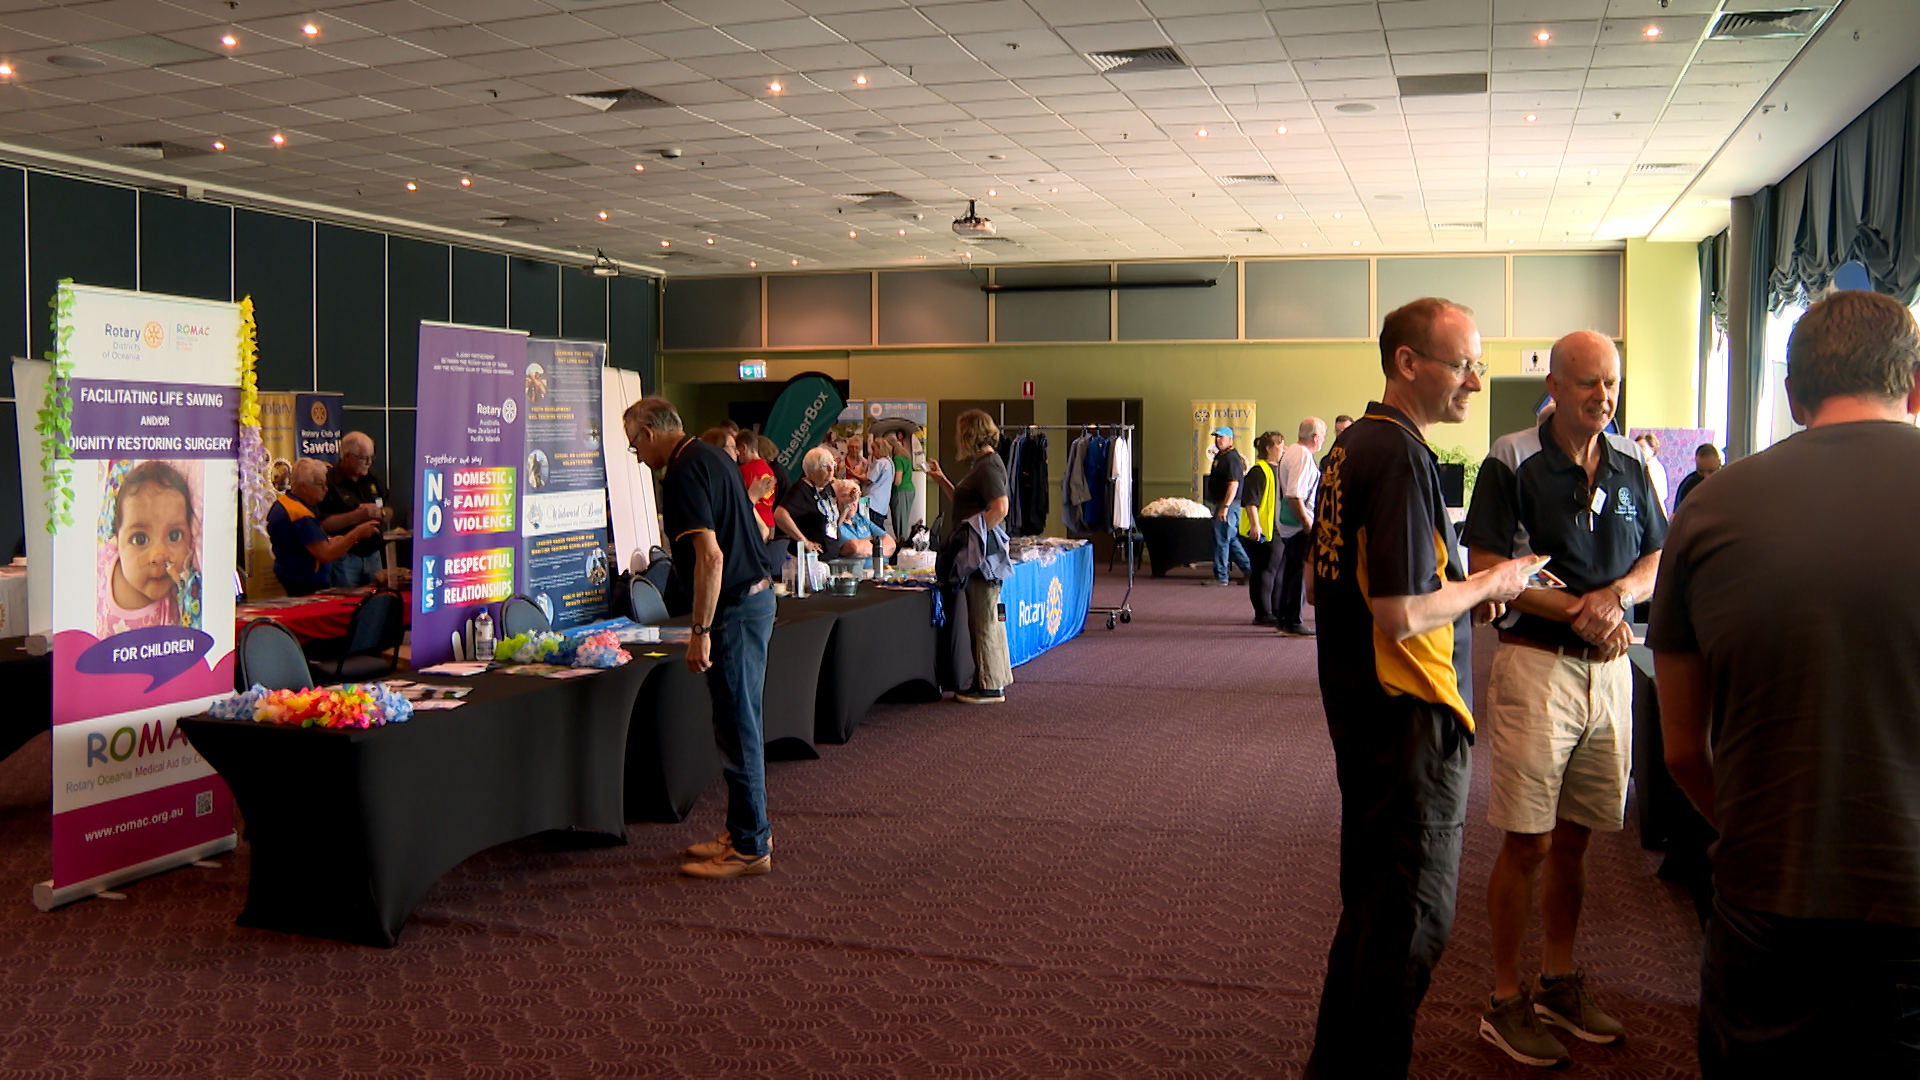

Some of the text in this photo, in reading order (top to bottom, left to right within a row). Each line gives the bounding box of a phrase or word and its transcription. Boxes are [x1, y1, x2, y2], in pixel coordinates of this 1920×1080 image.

[105, 323, 141, 341] Rotary
[176, 323, 210, 336] ROMAC
[113, 341, 141, 351] Districts
[102, 351, 141, 361] of Oceania
[81, 387, 223, 408] FACILITATING LIFE SAVING
[477, 403, 502, 418] Rotary
[1214, 408, 1251, 422] rotary
[320, 429, 334, 438] Club
[777, 391, 829, 467] ShelterBox
[67, 436, 233, 450] DIGNITY RESTORING SURGERY
[424, 453, 457, 467] Together
[453, 471, 506, 487] DOMESTIC
[427, 472, 443, 534] NO
[453, 493, 513, 509] FAMILY
[453, 513, 513, 532] VIOLENCE
[444, 553, 512, 576] RESPECTFUL
[425, 559, 435, 608] YES
[443, 580, 512, 605] RELATIONSHIPS
[1019, 600, 1046, 628] Rotary
[112, 638, 195, 664] FOR CHILDREN
[87, 719, 189, 768] ROMA
[65, 778, 96, 794] Rotary
[97, 770, 133, 786] Oceania
[135, 759, 165, 777] Medical
[166, 757, 180, 770] Aid
[181, 756, 193, 766] for
[84, 807, 184, 842] www.romac.org.au
